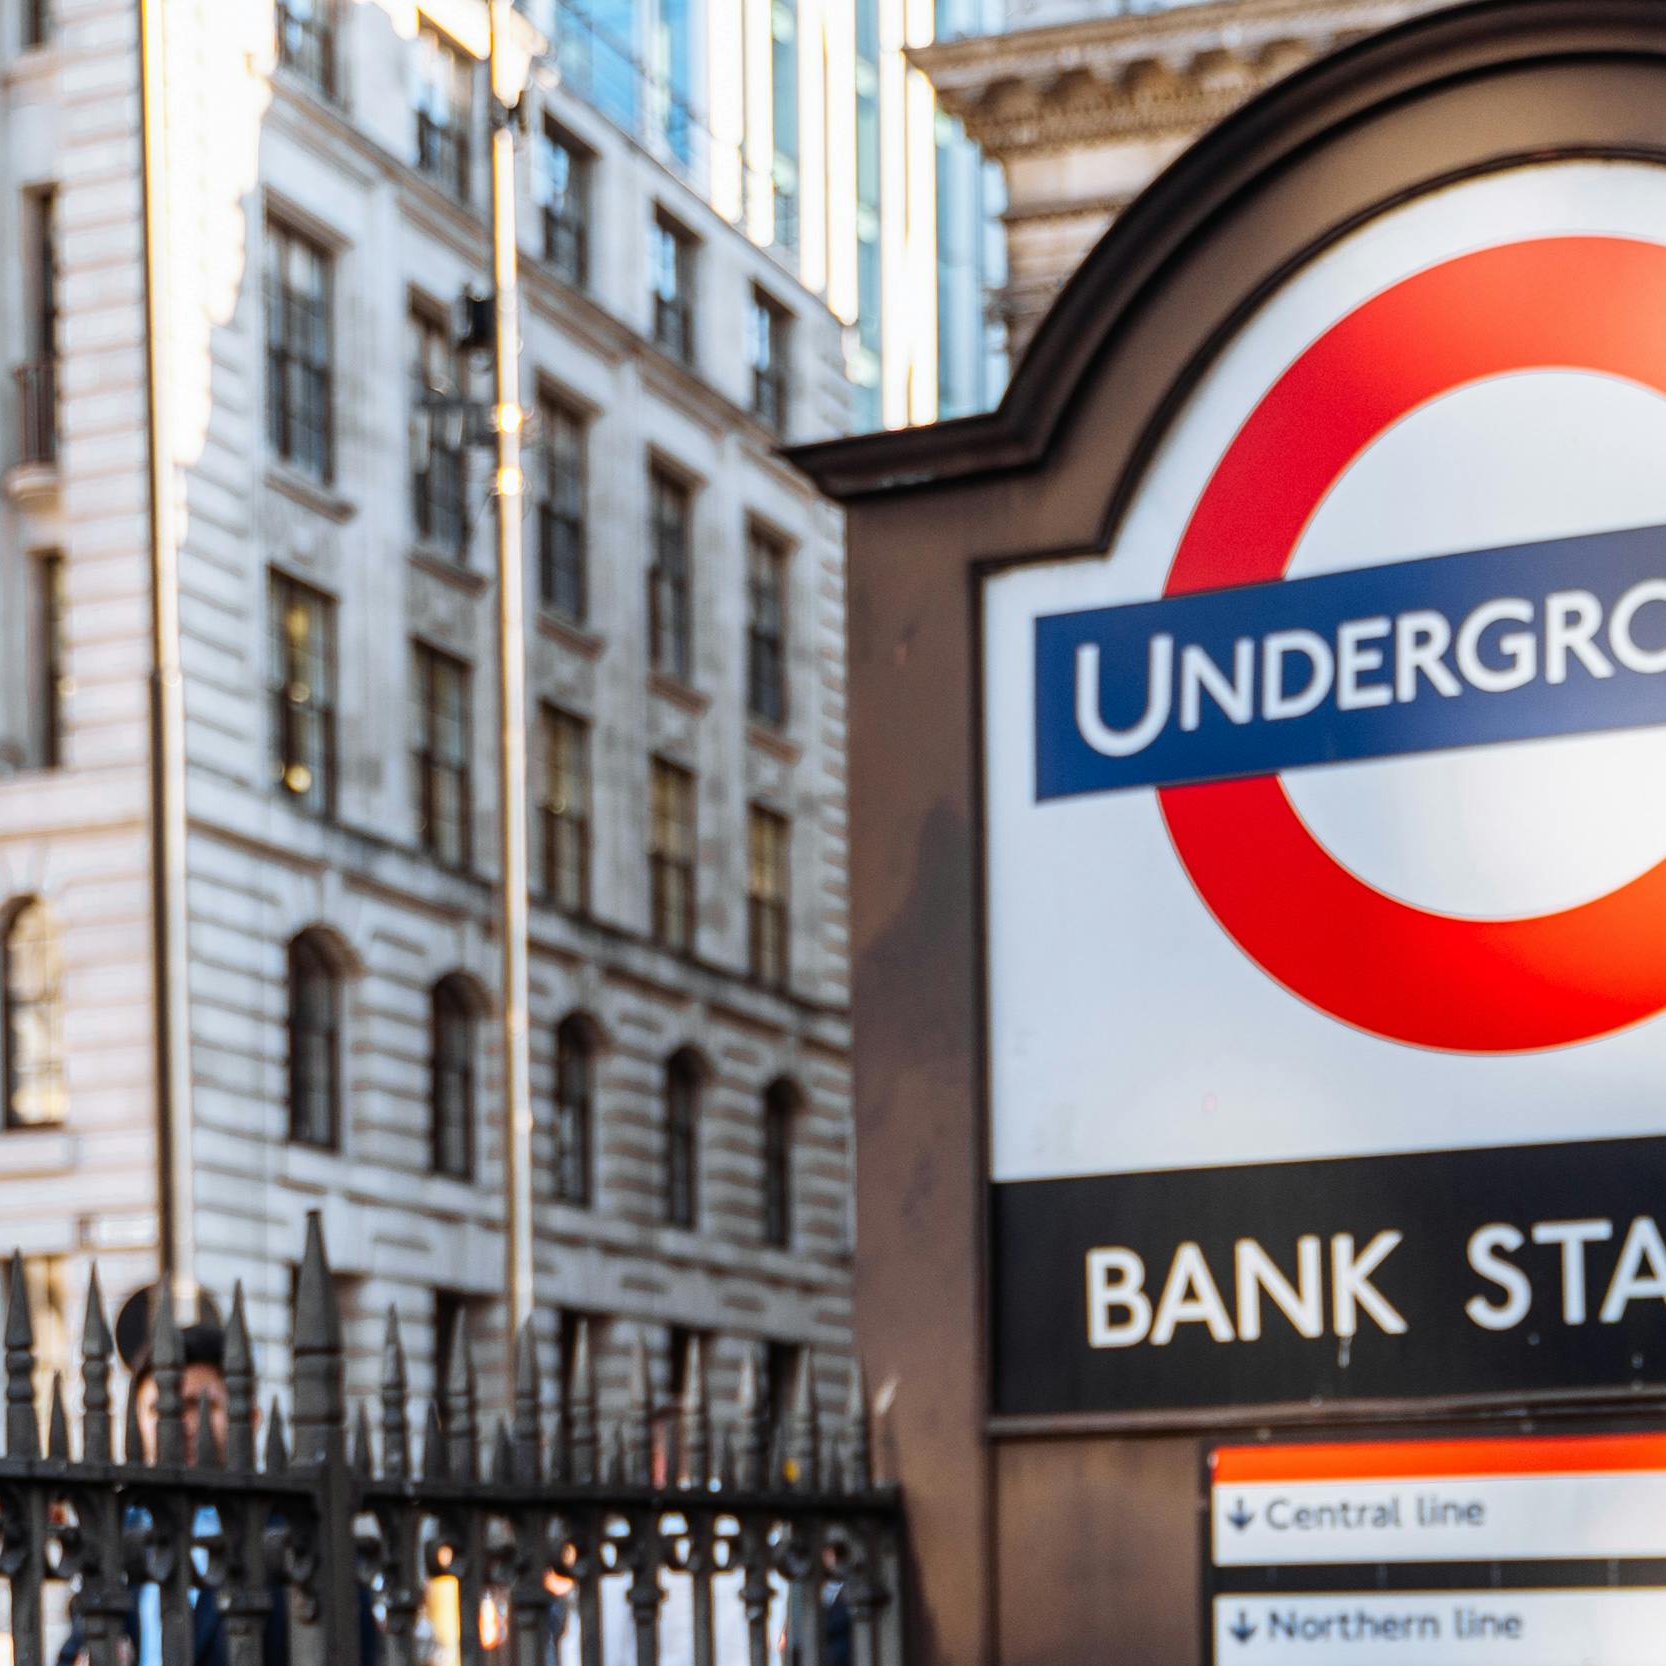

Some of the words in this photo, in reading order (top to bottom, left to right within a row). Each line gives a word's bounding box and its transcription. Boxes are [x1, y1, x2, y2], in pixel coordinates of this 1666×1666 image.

[1085, 1229, 1410, 1349] BANK
[1265, 1497, 1401, 1530] Central
[1417, 1496, 1486, 1527] line
[1268, 1610, 1441, 1642] Northern
[1454, 1606, 1523, 1640] line
